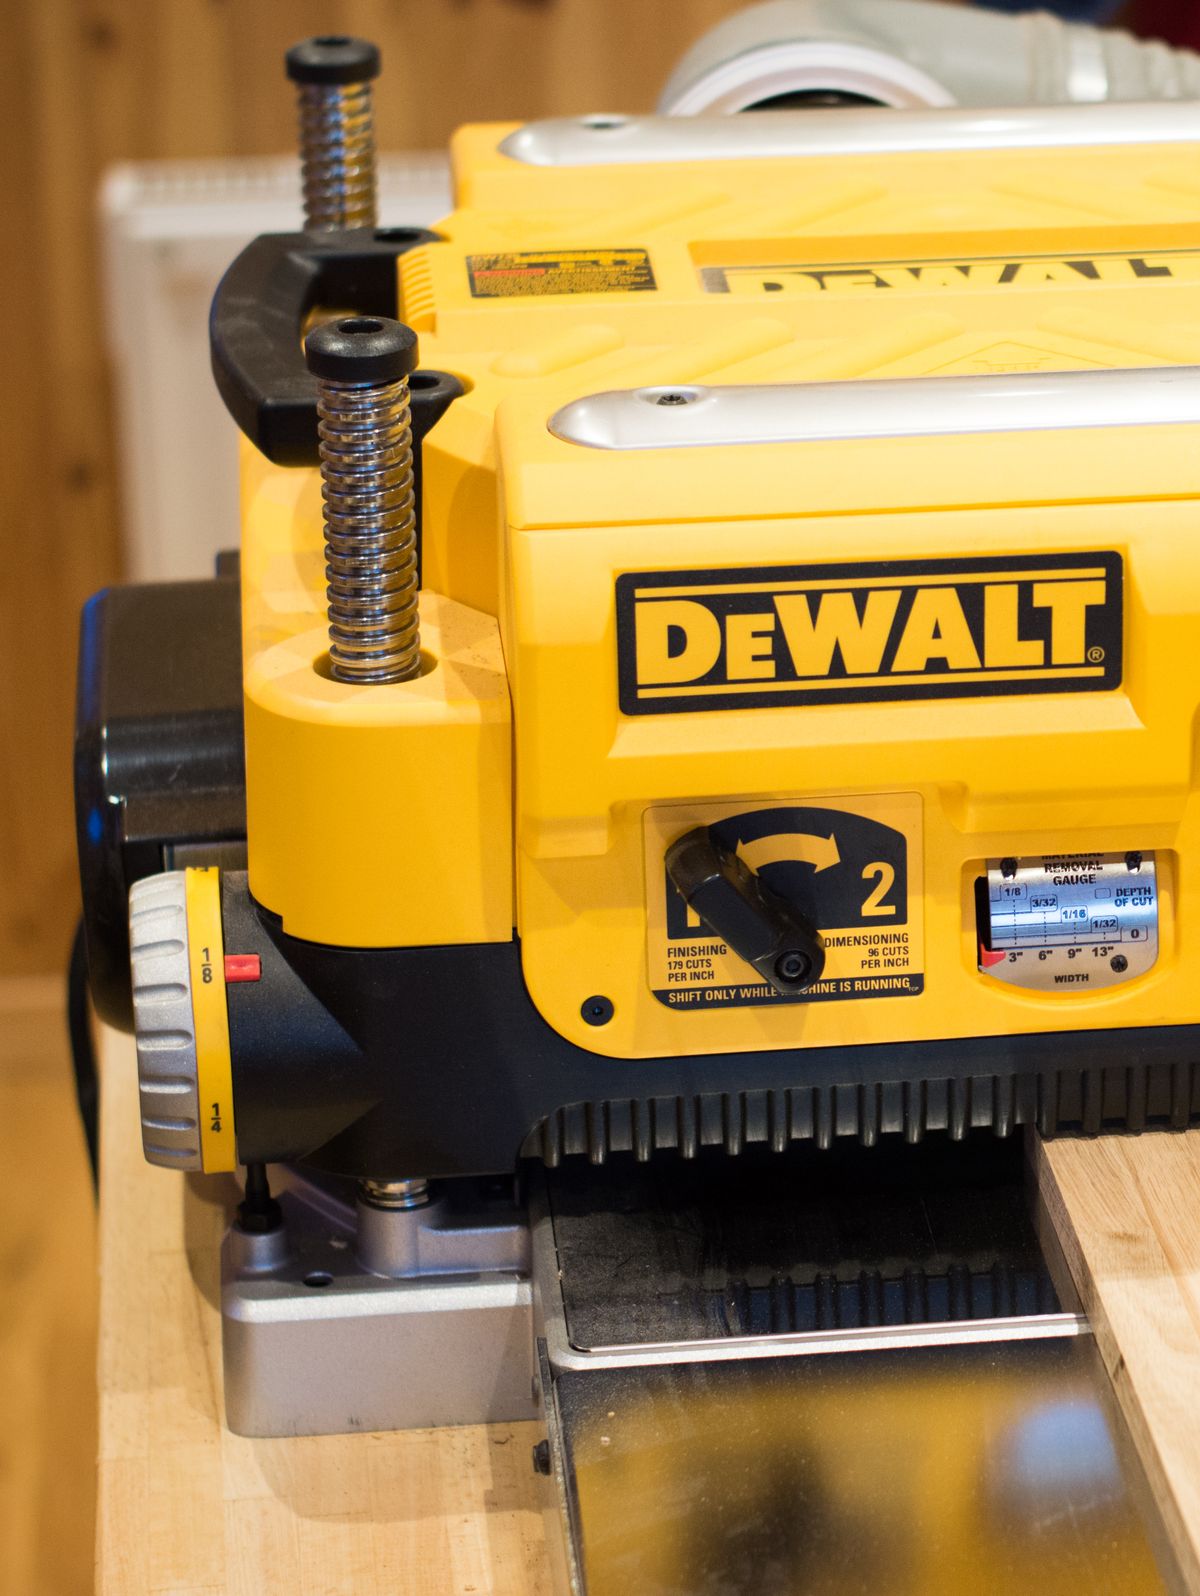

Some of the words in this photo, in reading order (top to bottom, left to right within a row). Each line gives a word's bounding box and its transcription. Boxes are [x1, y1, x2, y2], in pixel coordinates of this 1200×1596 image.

[635, 580, 1106, 685] DEWALT
[1044, 860, 1104, 873] REMOVAL
[1053, 874, 1097, 886] GAUGE
[861, 861, 896, 917] 2
[1004, 887, 1021, 897] 1/8
[1116, 886, 1151, 897] DEPTH
[1032, 898, 1057, 908] 3/32
[1115, 898, 1129, 907] OF
[1131, 896, 1154, 907] CUT
[1062, 909, 1086, 919] 1/16
[1093, 918, 1117, 929] 1/32
[1130, 928, 1140, 939] 0
[824, 933, 909, 948] DIMENSIONING
[667, 944, 727, 958] FINISHING
[868, 948, 879, 957] 96
[882, 946, 909, 957] CUTS
[667, 961, 683, 971] 179
[685, 958, 712, 970] CUTS
[861, 959, 881, 969] PER
[884, 957, 909, 968] INCH
[668, 972, 687, 983] PER
[690, 970, 715, 982] INCH
[1054, 973, 1089, 984] WIDTH
[669, 991, 702, 1003] SHIFT
[705, 988, 737, 1001] ONLY
[740, 986, 778, 999] WHILE
[840, 981, 851, 992] IS
[854, 977, 911, 990] RUNNING
